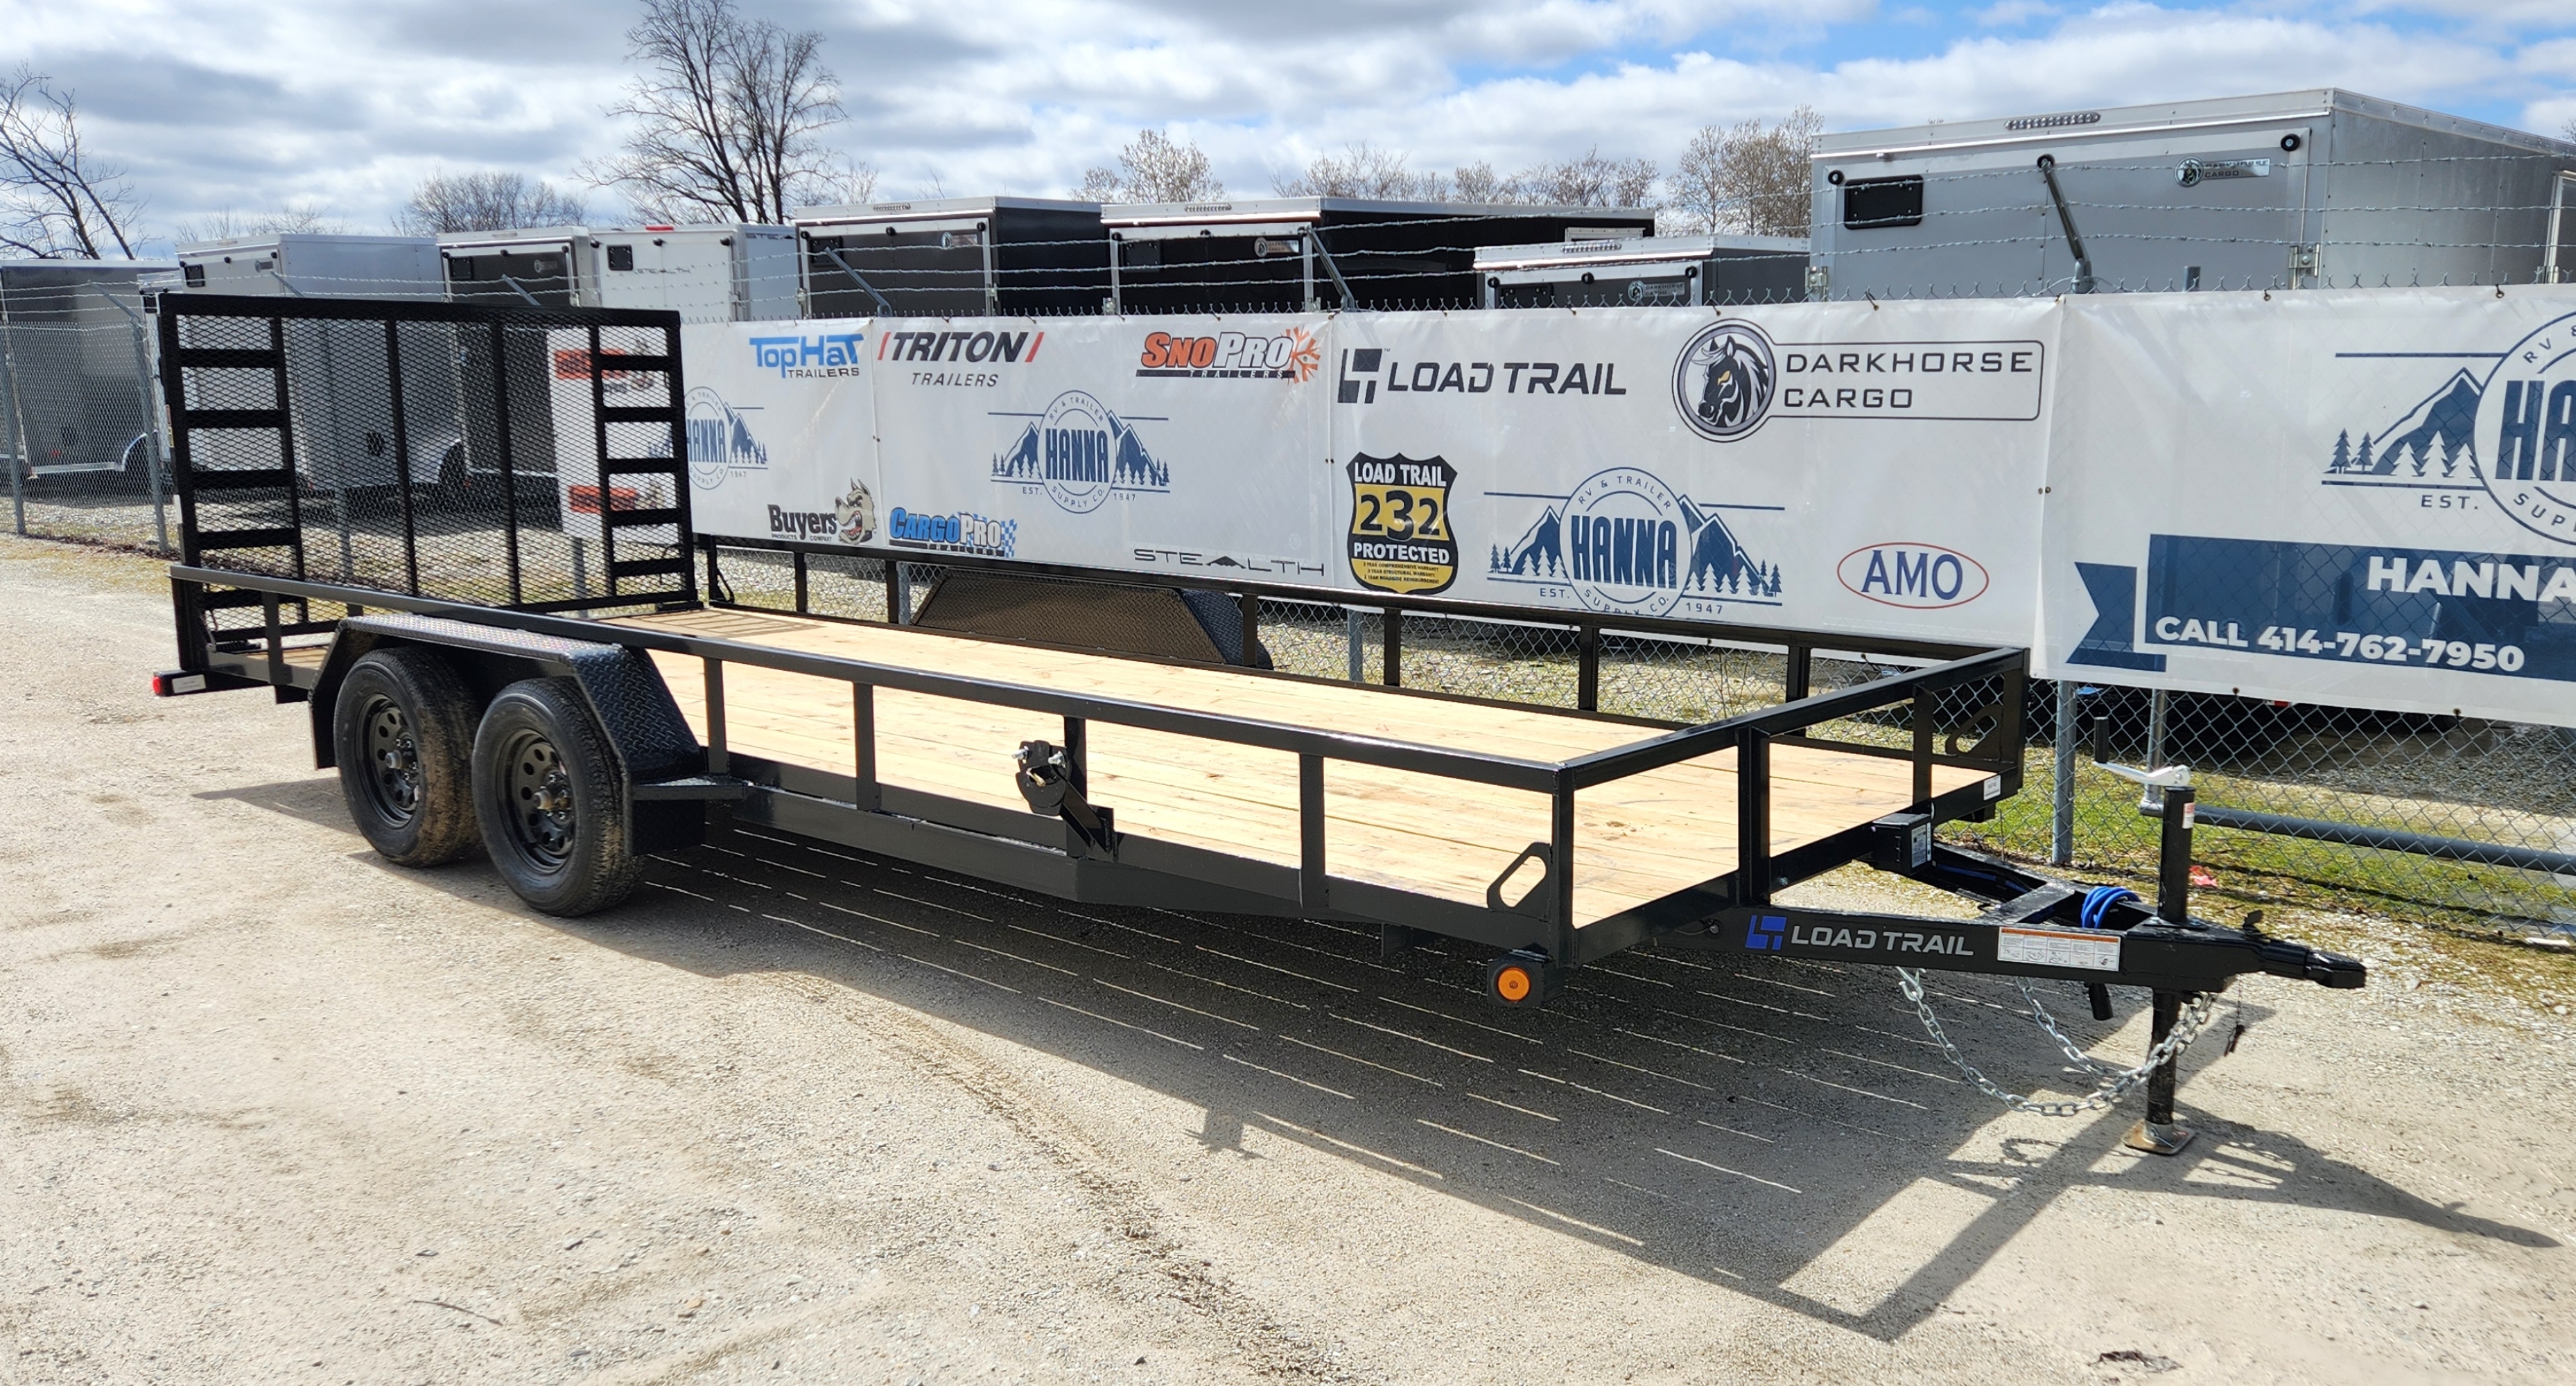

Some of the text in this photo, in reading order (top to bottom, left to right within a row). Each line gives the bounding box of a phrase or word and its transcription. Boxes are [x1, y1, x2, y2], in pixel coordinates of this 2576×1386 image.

[2205, 170, 2240, 178] CARGO
[891, 331, 1029, 363] TRITON
[2523, 337, 2551, 363] RV
[787, 367, 860, 378] TRAILERS
[1786, 352, 2033, 373] DARKHORSE
[912, 372, 999, 387] TRAILERS
[1190, 369, 1284, 379] TRAILERS
[1387, 362, 1627, 395] LOAD TRAIL
[1070, 396, 1104, 422] TRAILER
[1784, 388, 1913, 408] CARGO
[1045, 428, 1109, 483] HANNA
[1355, 462, 1447, 486] LOAD TRAIL
[1022, 486, 1042, 495] EST.
[1052, 486, 1088, 508] SUPPLY
[1113, 493, 1135, 501] 1947
[1578, 476, 1671, 509] RV & TRAILER
[2421, 494, 2478, 509] EST.
[767, 504, 837, 540] Buyers
[1360, 490, 1441, 542] 232
[926, 543, 997, 556] TRAILERS
[1354, 542, 1450, 564] PROTECTED
[1572, 515, 1677, 589] HANNA
[1861, 550, 1963, 600] AMO
[1540, 588, 1569, 599] EST.
[1686, 602, 1723, 615] 1947
[2155, 616, 2525, 672] CALL 414-762-7950
[1791, 925, 1877, 949] LOAD
[1883, 931, 1974, 956] TRAIL
